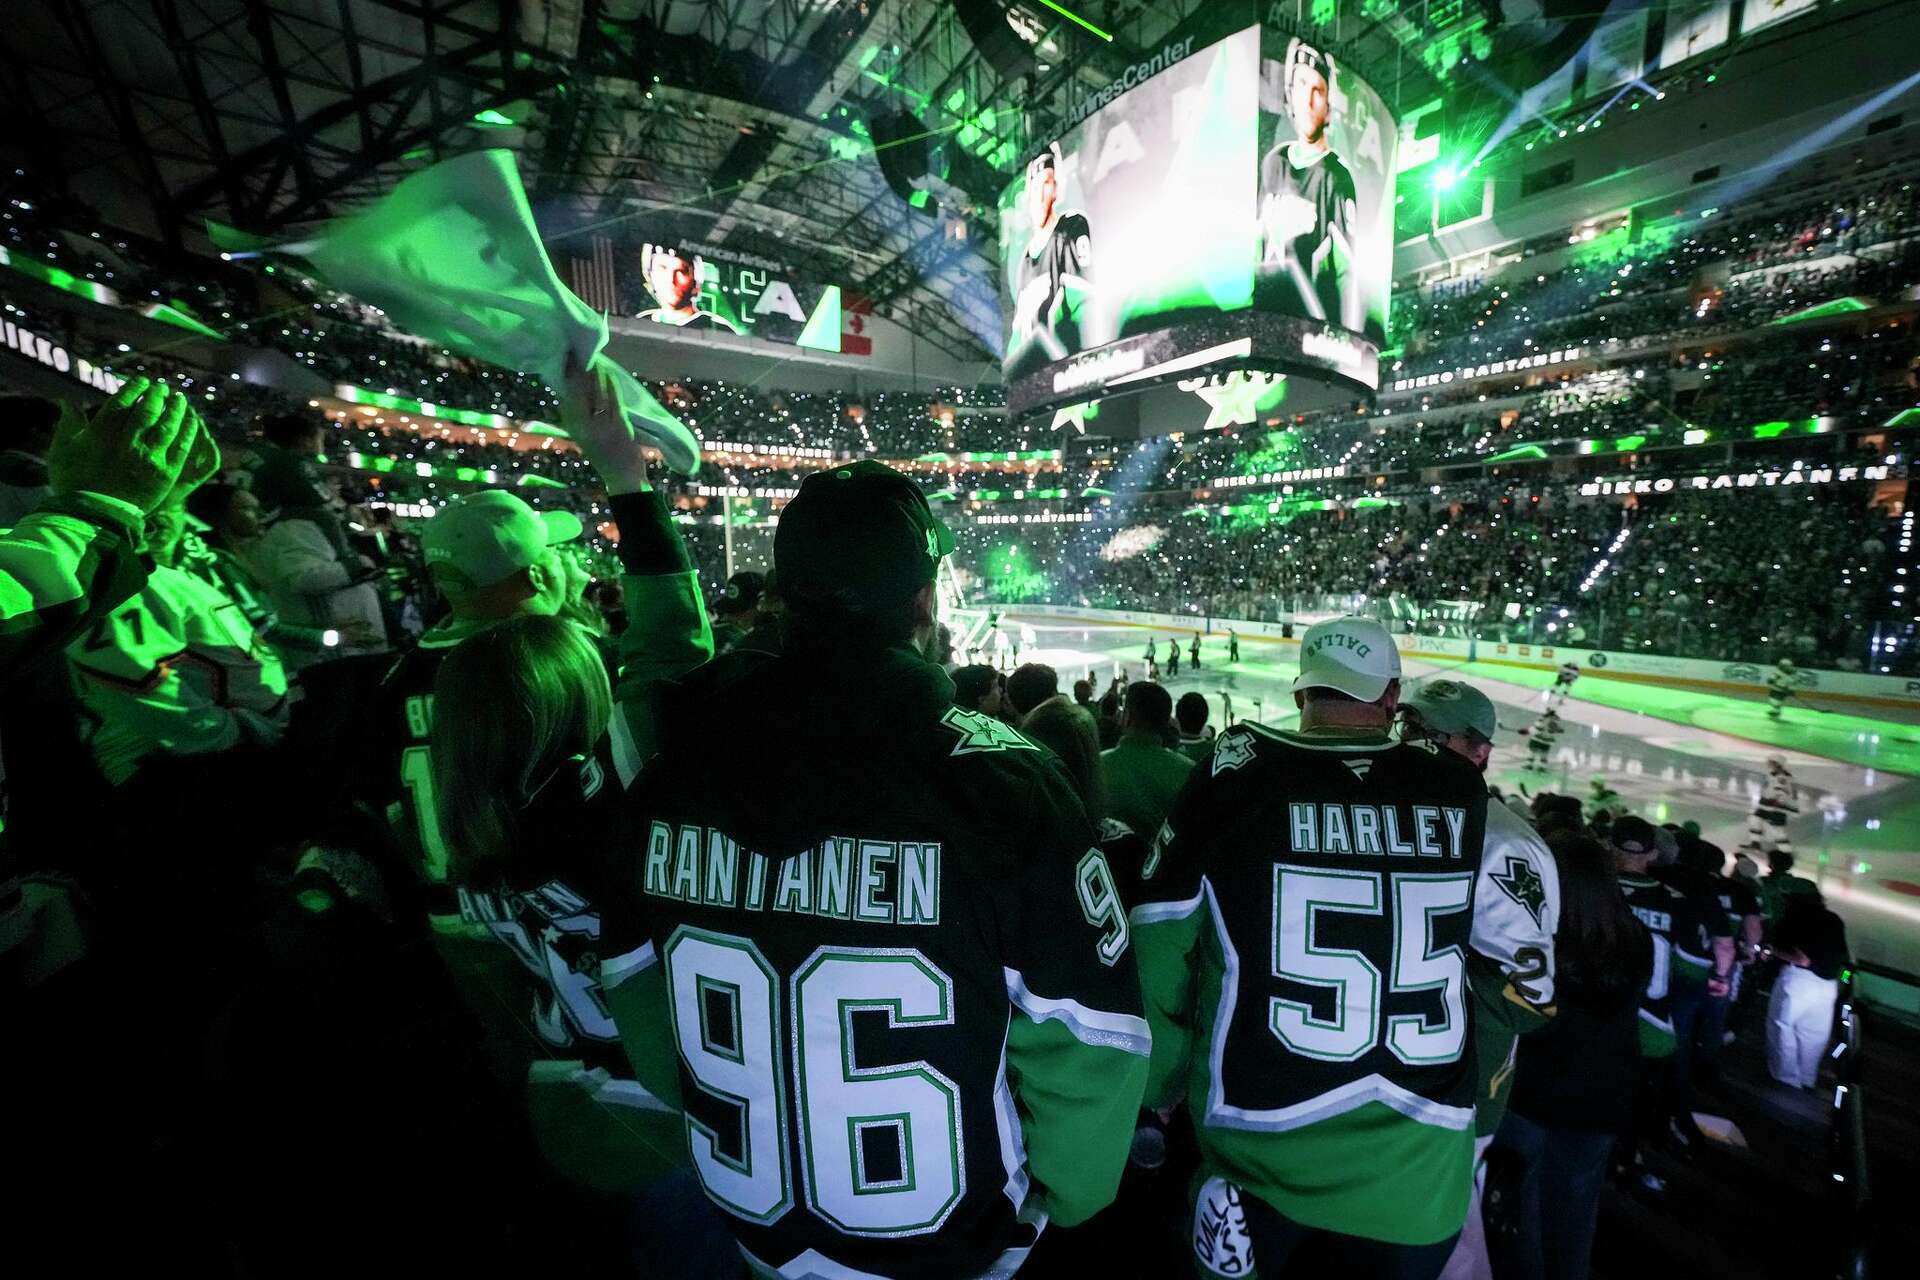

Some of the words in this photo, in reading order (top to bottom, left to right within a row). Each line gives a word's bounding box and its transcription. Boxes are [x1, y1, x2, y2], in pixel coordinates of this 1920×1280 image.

[1393, 371, 1454, 392] MIKKO
[1463, 348, 1579, 380] RANTANEN
[1579, 477, 1674, 496] MIKKO
[1691, 465, 1889, 490] RANTANEN
[1288, 802, 1467, 859] HARLEY
[1075, 847, 1129, 967] 9
[1268, 862, 1475, 1067] 55
[664, 924, 967, 1238] 96
